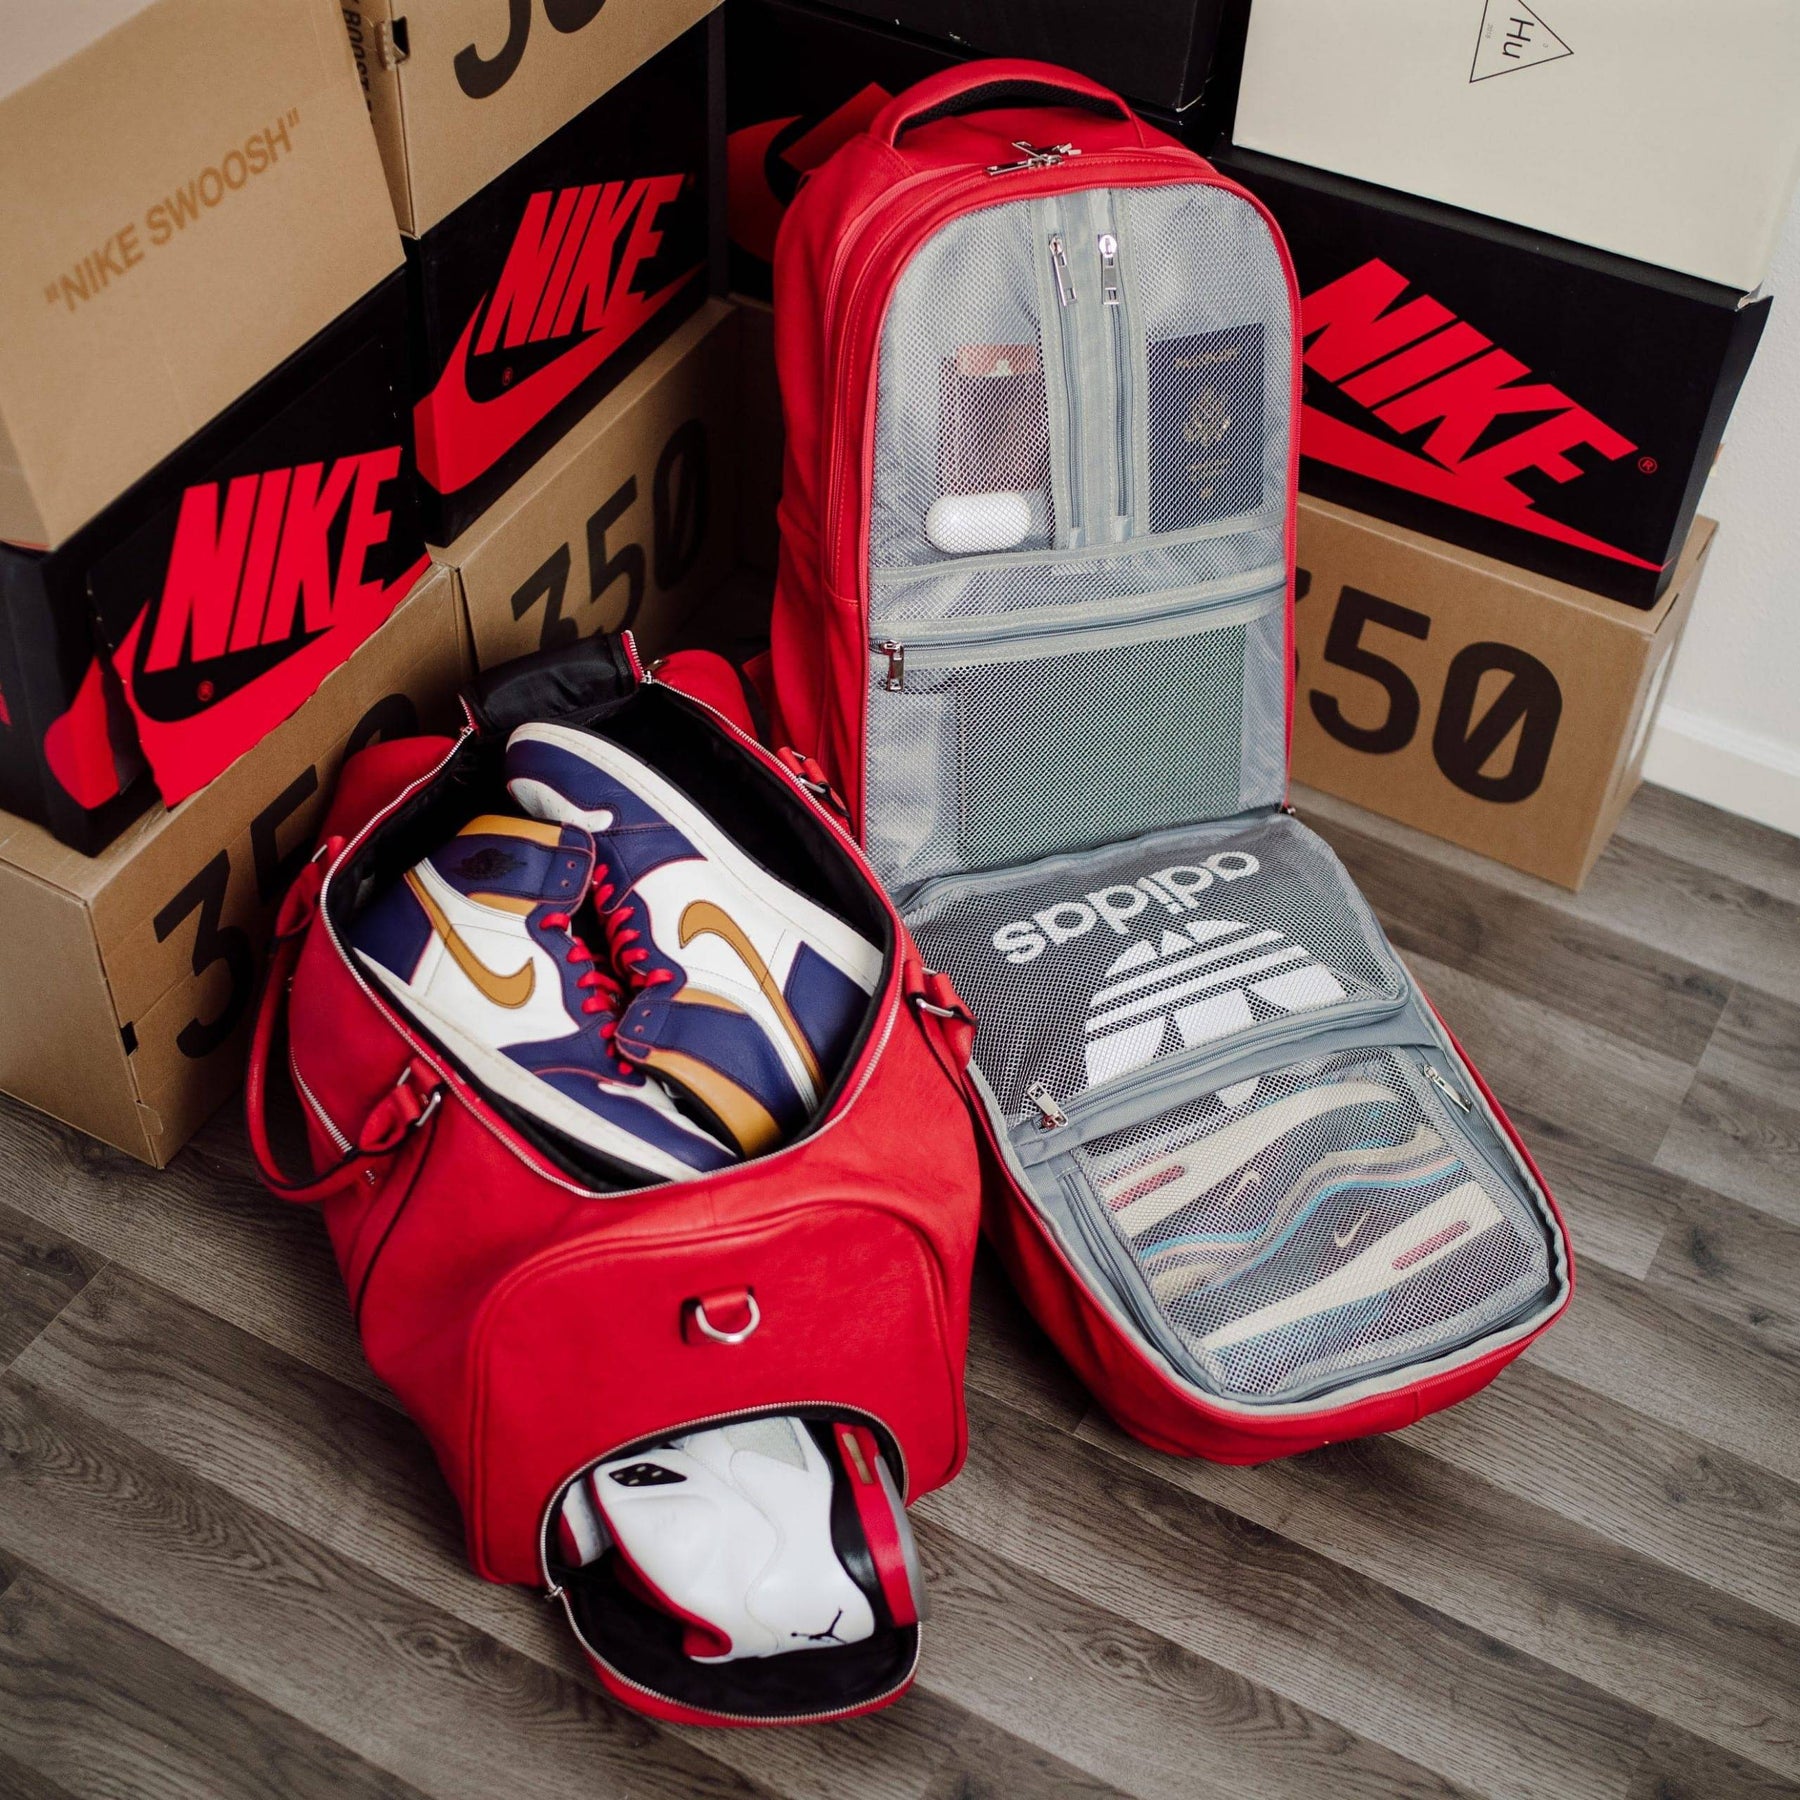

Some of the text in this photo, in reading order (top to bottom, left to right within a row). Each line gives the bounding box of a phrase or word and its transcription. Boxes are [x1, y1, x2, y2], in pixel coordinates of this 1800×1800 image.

[1502, 17, 1535, 59] Hu
[474, 173, 685, 357] NIKE
[1302, 257, 1639, 510] NIKE
[144, 445, 401, 674] NIKE
[1295, 567, 1563, 805] 50
[992, 851, 1260, 964] adidas
